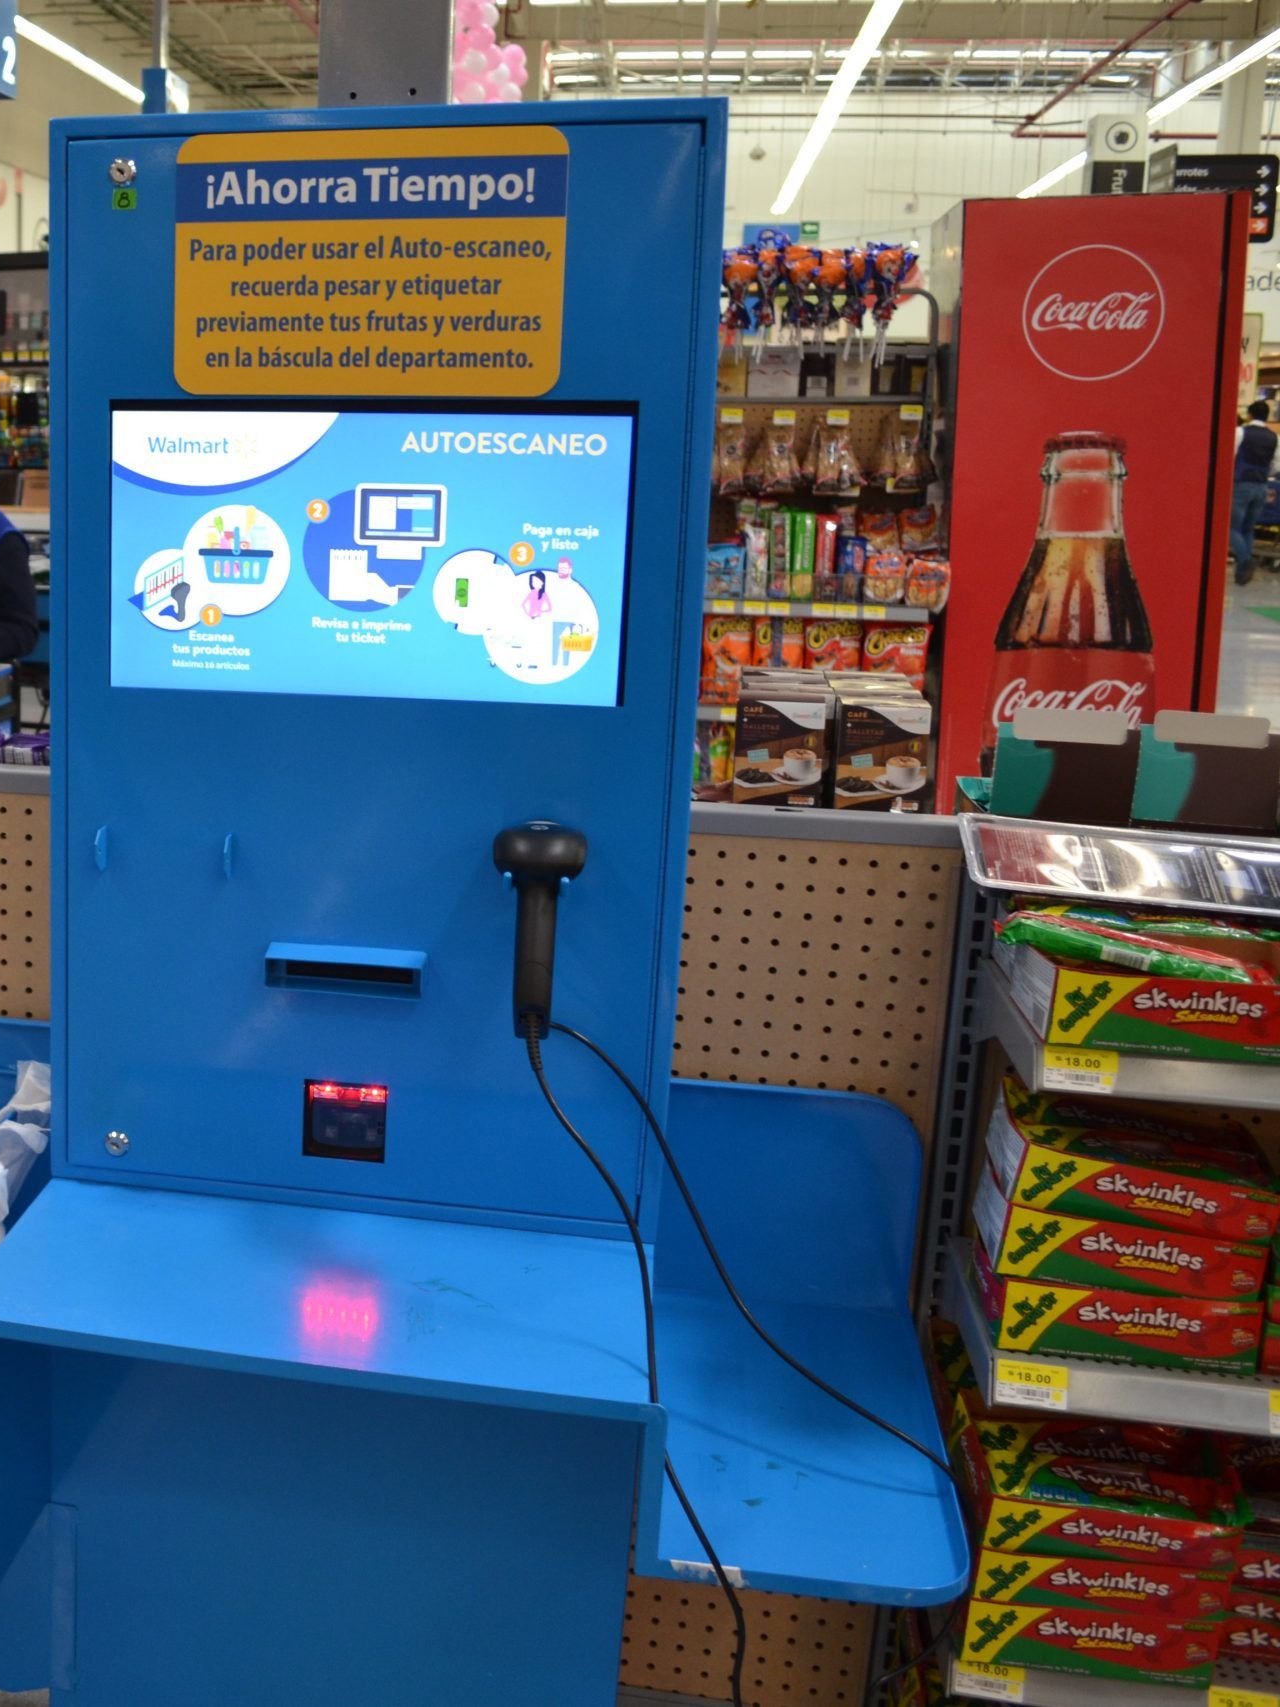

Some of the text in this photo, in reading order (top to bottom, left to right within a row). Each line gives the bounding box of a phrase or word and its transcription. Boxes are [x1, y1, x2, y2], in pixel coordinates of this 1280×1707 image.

[1, 36, 17, 84] 2
[207, 166, 536, 210] ¡Ahorra Tiempo!
[190, 236, 552, 264] Para poder usar el Auto-escaneo,
[231, 275, 501, 301] recuerda pesar y etiquetar
[196, 311, 541, 337] previamente tus frutas y verduras
[1031, 291, 1158, 332] Coca-Cola
[205, 346, 534, 373] en la báscula del departamento.
[148, 436, 229, 454] Walmart
[401, 432, 607, 456] AUTOESCANEO
[523, 523, 599, 540] Paga en caja
[542, 538, 579, 552] y listo
[189, 630, 235, 643] Escanea
[312, 617, 412, 632] Revisa e imprime
[172, 643, 251, 657] tus productos
[336, 632, 386, 645] tu ticket
[865, 627, 927, 656] Cheetos
